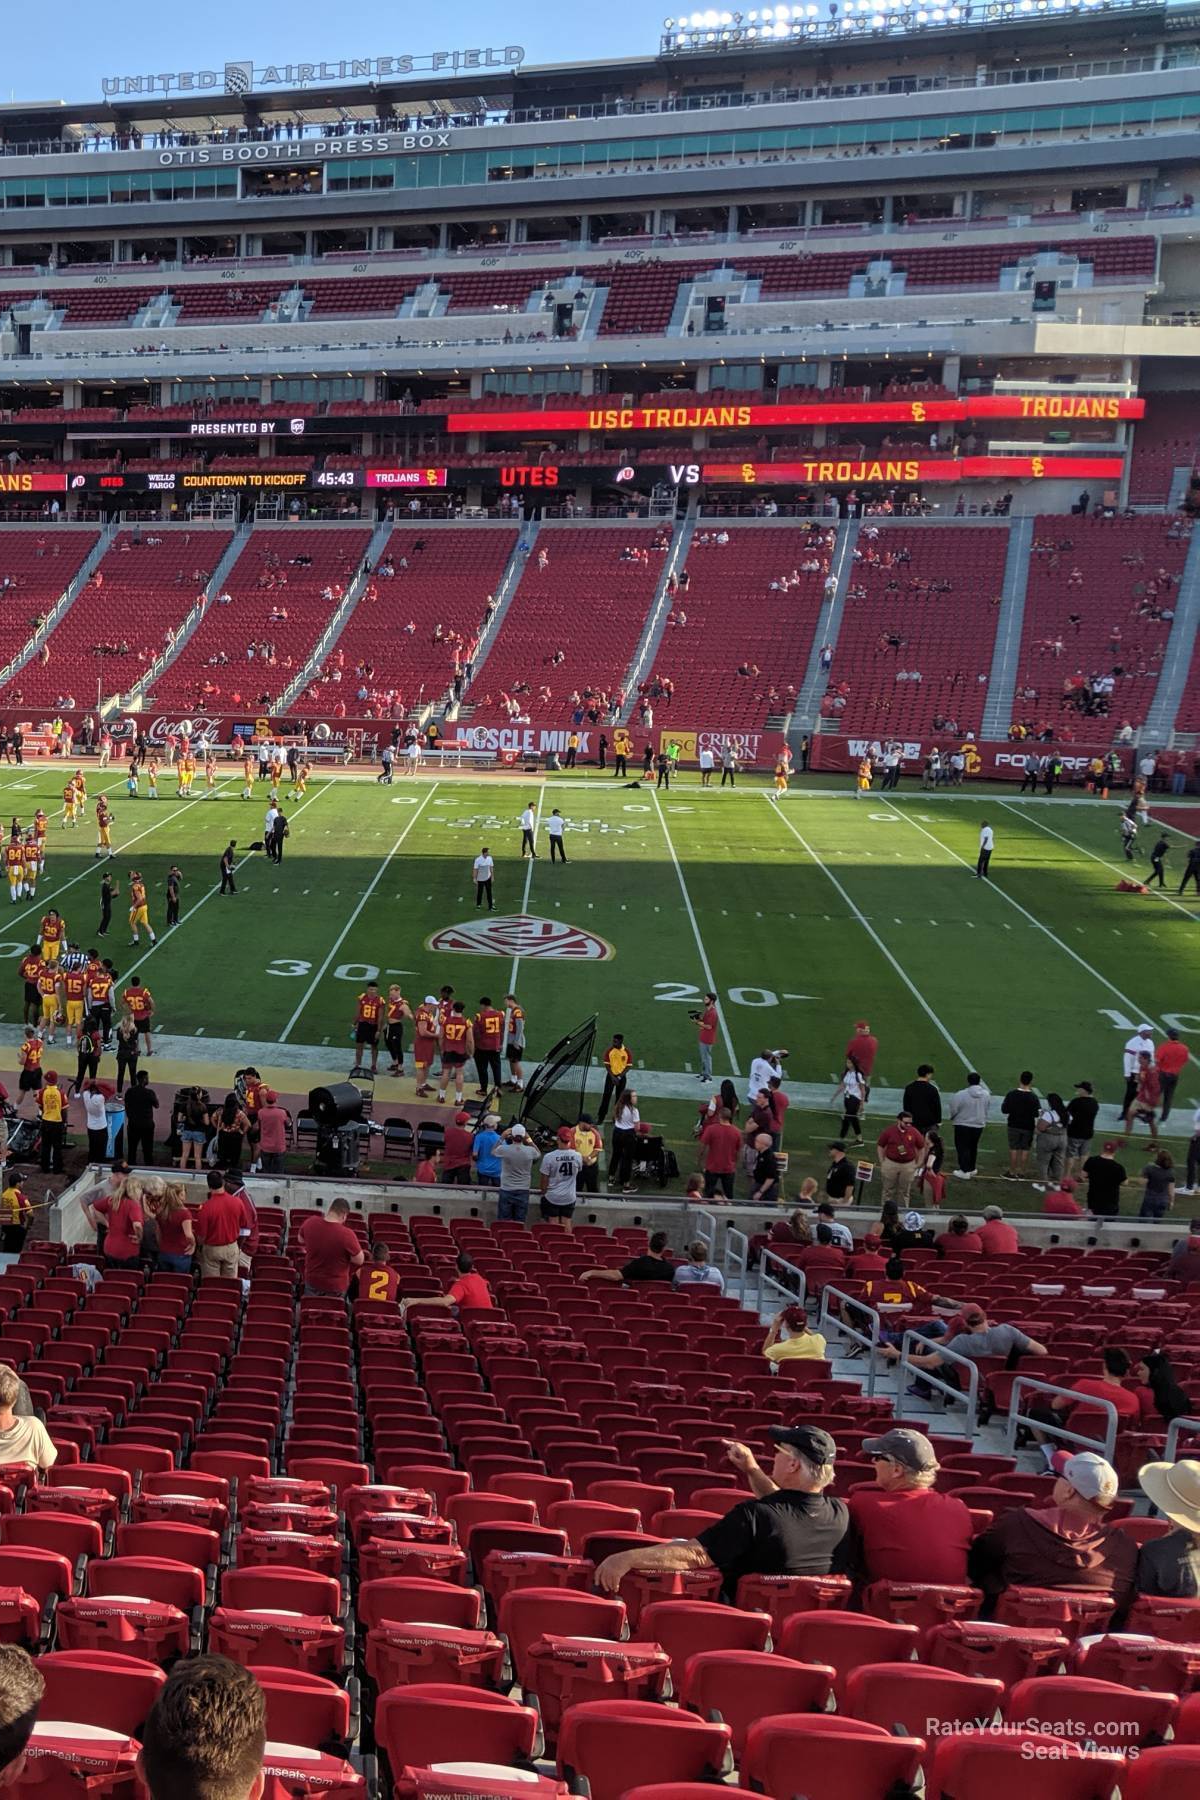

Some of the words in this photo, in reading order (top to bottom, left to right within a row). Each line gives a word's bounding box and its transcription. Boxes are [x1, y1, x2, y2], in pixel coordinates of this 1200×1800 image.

[102, 70, 216, 95] UNITED
[261, 54, 413, 84] AIRLINES
[432, 46, 525, 71] FIELD
[159, 149, 210, 165] OTIS
[222, 143, 301, 162] BOOTH
[314, 138, 390, 156] PRESS
[403, 133, 452, 149] BOX
[1020, 397, 1120, 418] TROJANS
[589, 410, 634, 429] USC
[642, 406, 751, 428] TROJANS
[191, 423, 257, 434] PRESENTED
[261, 422, 276, 433] BY
[375, 473, 420, 482] TROJANS
[501, 466, 559, 486] UTES
[670, 465, 700, 484] VS
[804, 461, 919, 481] TROJANS
[148, 482, 175, 490] FARGO
[183, 475, 248, 487] COUNTDOWN
[250, 475, 262, 485] TO
[264, 474, 306, 485] KICKOFF
[317, 473, 354, 486] 45:43
[698, 745, 759, 760] UNON
[8, 849, 22, 861] 84
[25, 847, 38, 858] 82
[265, 959, 381, 981] 30
[67, 979, 82, 992] 15
[91, 984, 109, 998] 27
[653, 982, 780, 1007] 20
[127, 997, 144, 1011] 36
[363, 1006, 376, 1019] 81
[445, 1024, 466, 1041] 97
[486, 1017, 500, 1033] 51
[559, 1162, 573, 1177] 41
[369, 1270, 389, 1300] 2
[24, 1747, 108, 1766] rojanseats.com
